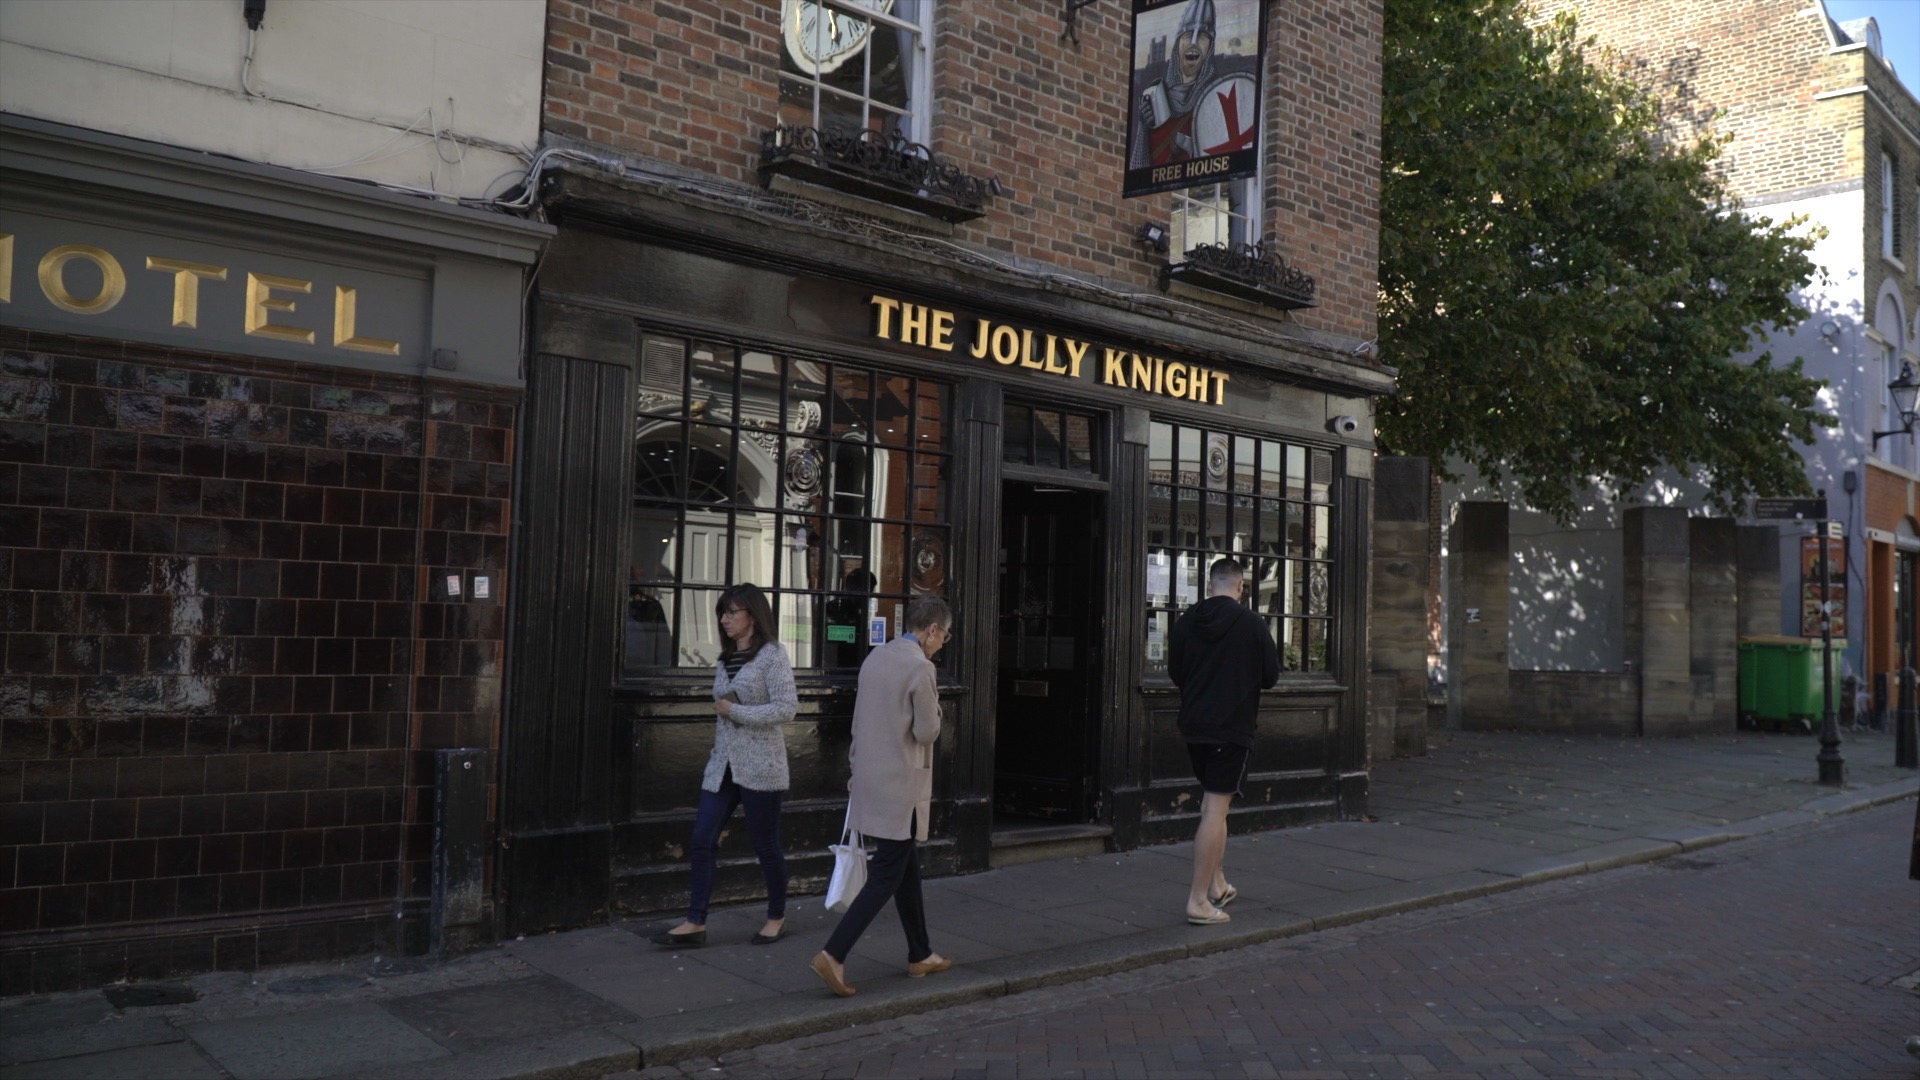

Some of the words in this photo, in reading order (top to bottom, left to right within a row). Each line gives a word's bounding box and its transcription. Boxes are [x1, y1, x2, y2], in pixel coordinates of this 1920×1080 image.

[1151, 164, 1182, 184] FREE
[1186, 155, 1230, 177] HOUSE
[870, 294, 955, 352] THE
[968, 318, 1091, 378] JOLLY
[1103, 347, 1230, 405] KNIGHT
